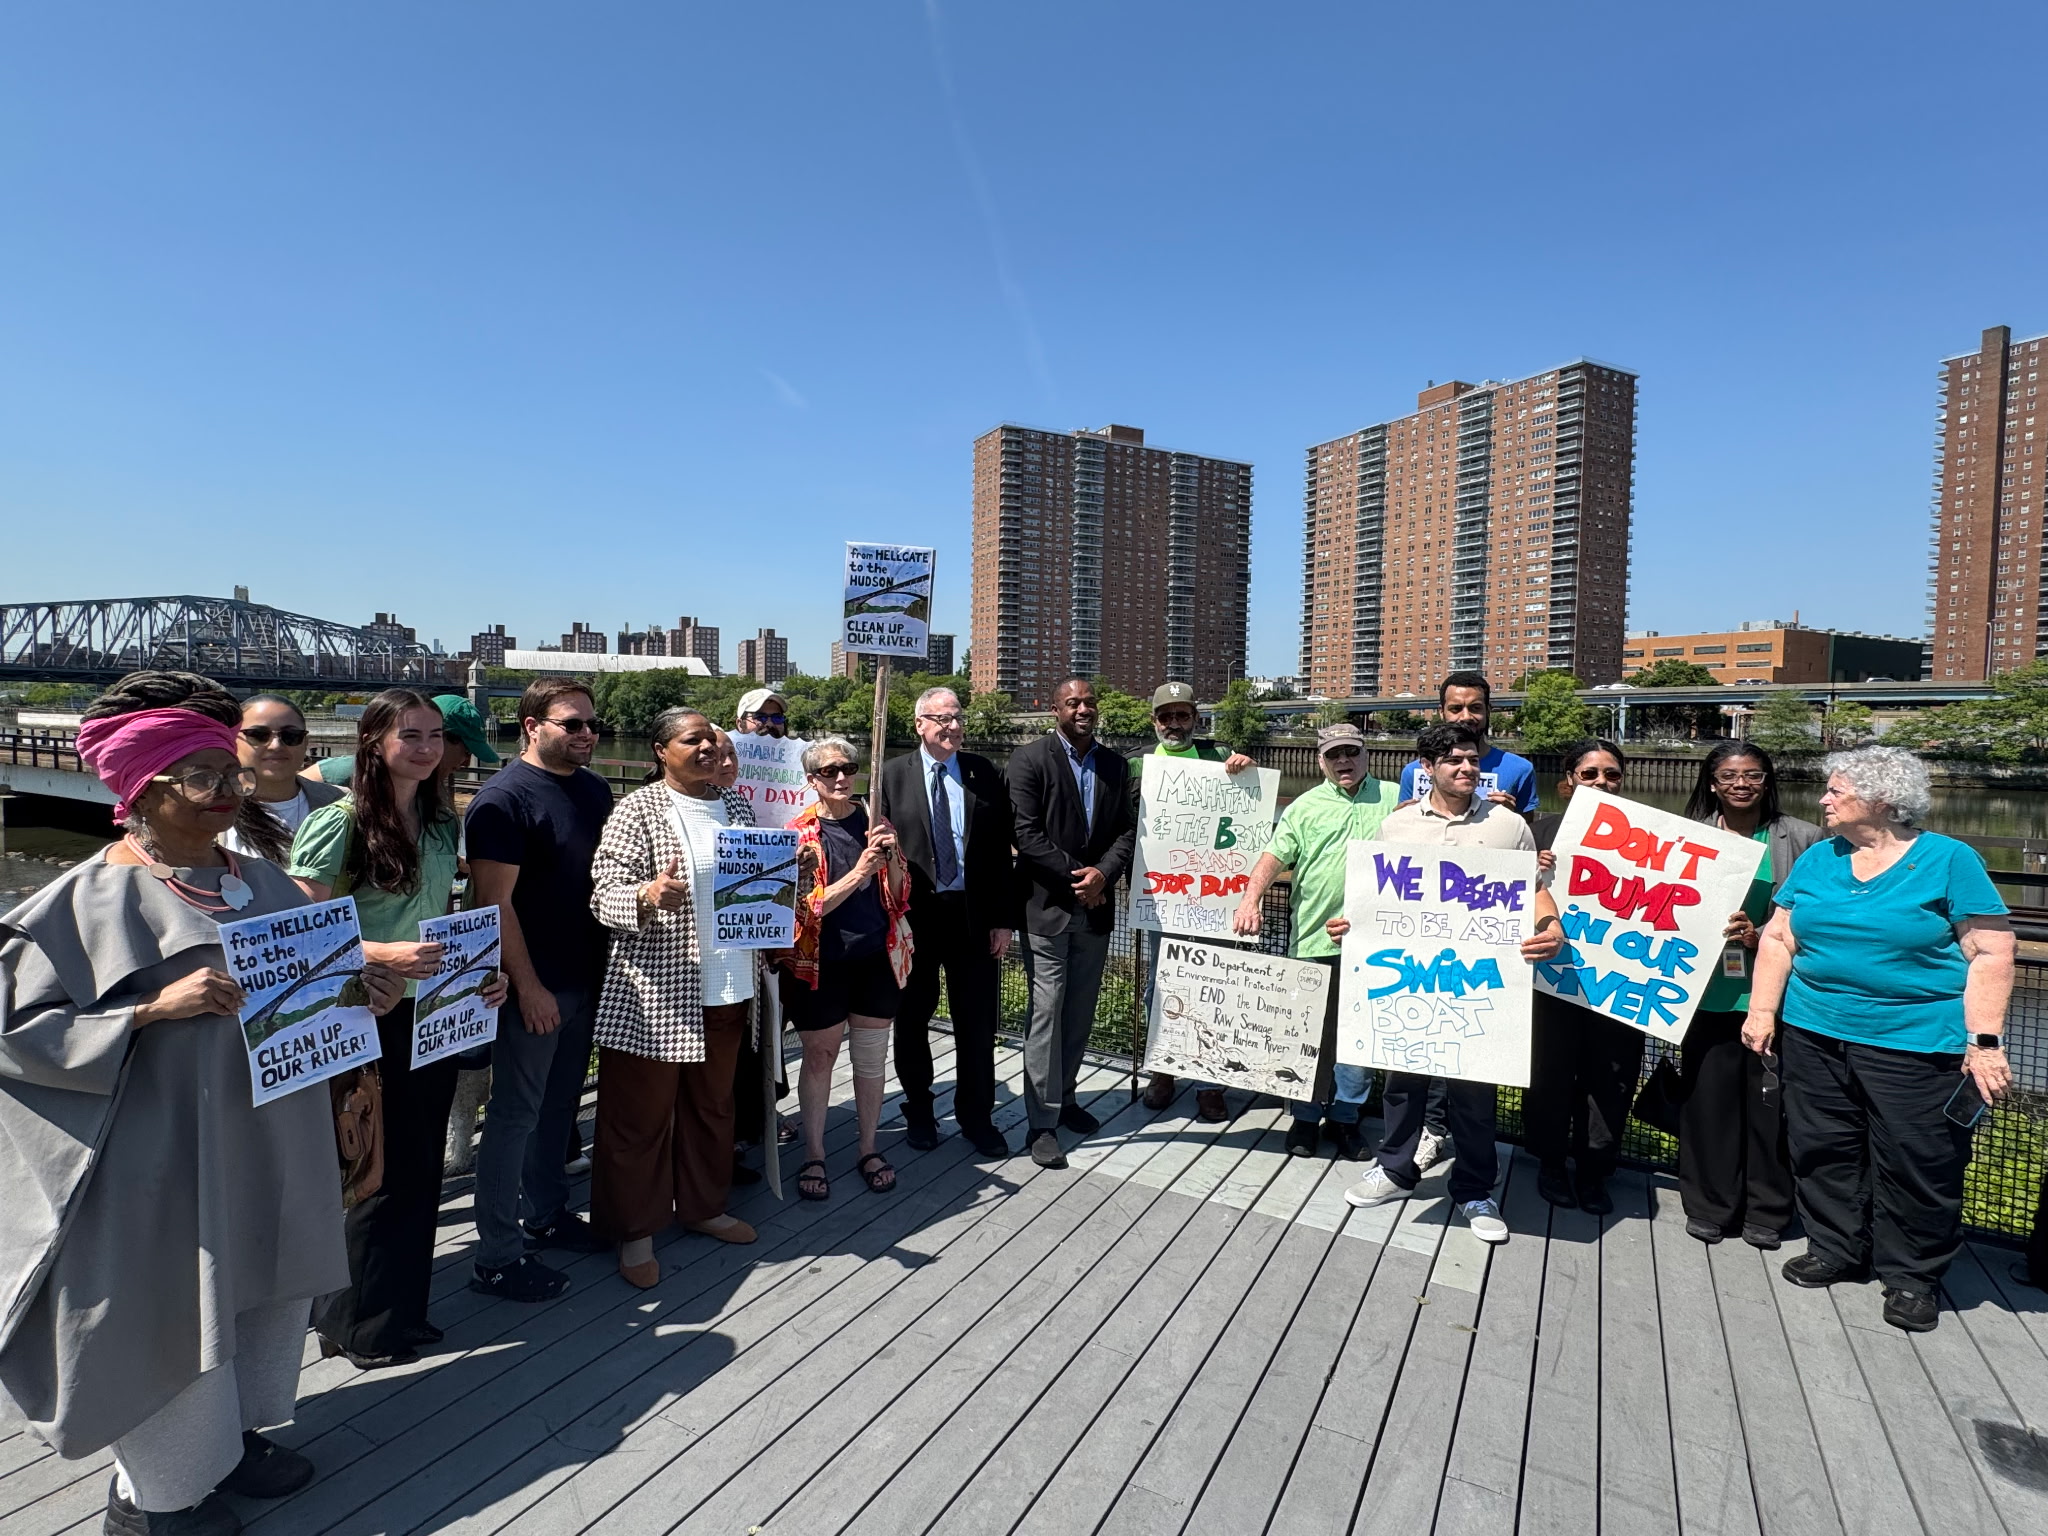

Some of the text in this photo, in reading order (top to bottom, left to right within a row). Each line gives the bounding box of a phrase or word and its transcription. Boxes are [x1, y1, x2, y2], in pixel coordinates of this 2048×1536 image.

[849, 561, 888, 574] to the
[850, 548, 928, 563] from HELLGATE
[850, 575, 894, 587] HUDSON
[847, 620, 904, 634] CLEAN UP
[847, 632, 918, 648] OUR RIVER!
[764, 787, 805, 806] DAY!
[1156, 770, 1261, 814] MANHATTAN
[717, 832, 796, 846] from HELLGATE
[1152, 808, 1172, 840] &
[1176, 814, 1210, 846] THE
[1580, 802, 1720, 880] DON'T
[718, 848, 757, 860] to the
[718, 862, 764, 874] HUDSON
[1169, 848, 1248, 873] DEMAND
[1143, 872, 1194, 895] STOP
[1372, 852, 1526, 913] WE DESERVE
[1568, 855, 1702, 931] DUMP
[230, 905, 352, 950] from HELLGATE
[425, 912, 496, 942] from HELLGATE
[717, 913, 772, 926] CLEAN UP
[1136, 899, 1168, 924] THE
[1172, 904, 1228, 932] HARLEM
[1376, 911, 1522, 946] TO BE ABLE
[442, 941, 462, 955] the
[718, 926, 786, 940] OUR RIVER!
[233, 944, 296, 972] to the
[1167, 944, 1286, 982] NYS Department of
[1612, 930, 1699, 978] OUR
[240, 958, 310, 992] HUDSON
[1200, 986, 1313, 1021] END the Dumping of
[1370, 995, 1494, 1038] BOAT
[418, 1008, 475, 1040] CLEAN UP
[418, 1020, 488, 1056] OUR RIVER!
[1214, 1007, 1299, 1038] RAW Sewage into
[258, 1022, 342, 1069] CLEAN UP
[1216, 1029, 1320, 1059] our Harlem River NOW
[262, 1034, 367, 1088] OUR RIVER!
